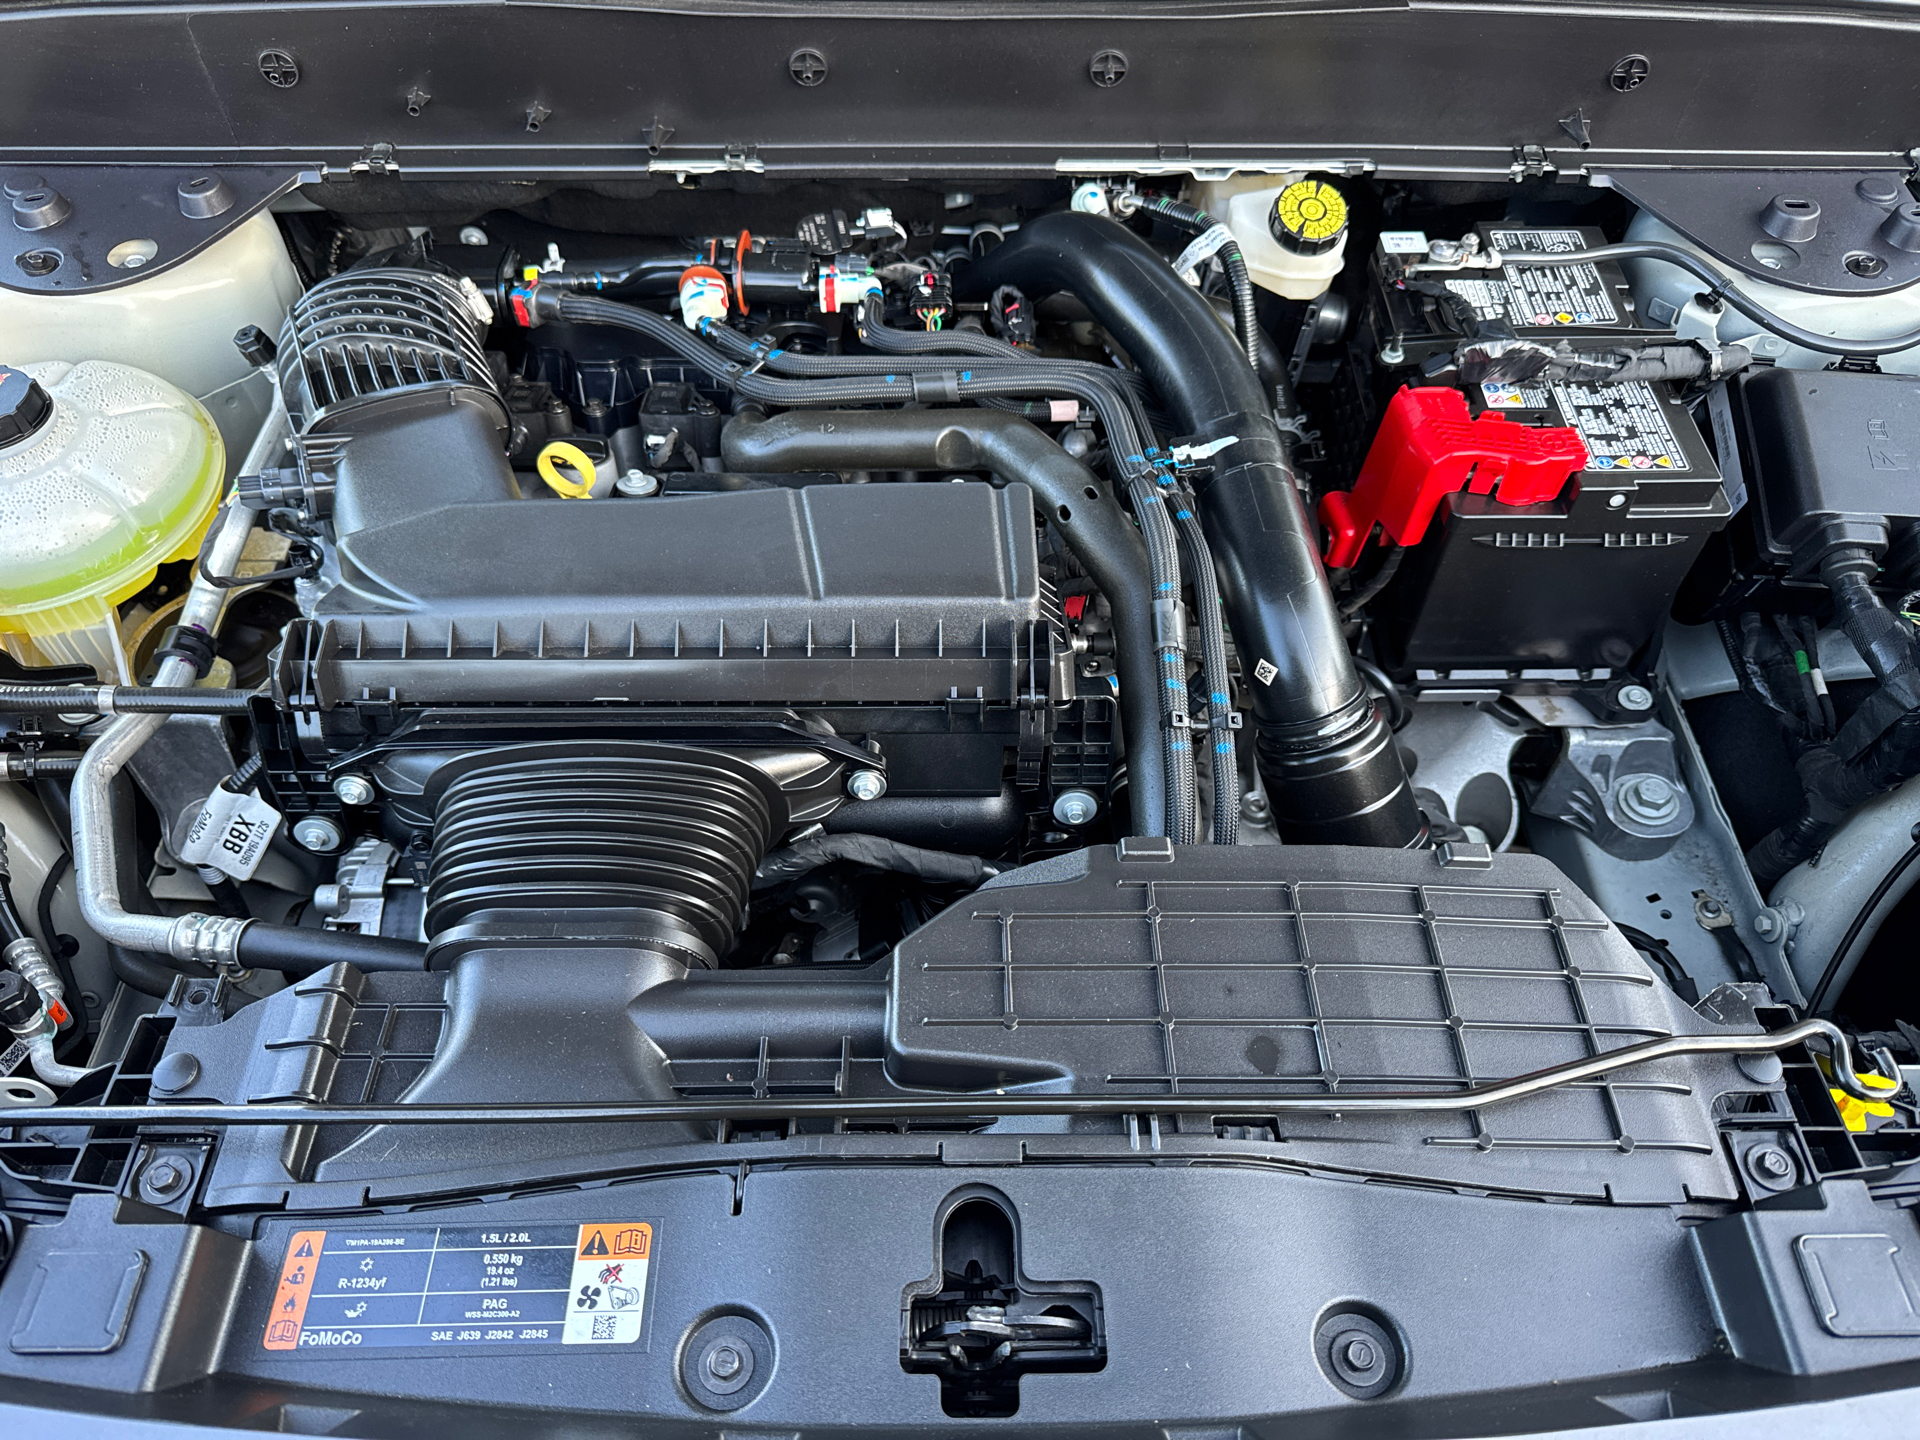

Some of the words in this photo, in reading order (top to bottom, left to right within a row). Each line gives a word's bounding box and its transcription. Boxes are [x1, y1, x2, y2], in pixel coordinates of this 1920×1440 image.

[189, 808, 213, 844] FoMoCo
[222, 813, 256, 855] XBB
[481, 1233, 502, 1243] 1.5L
[509, 1232, 532, 1242] 2.0L
[483, 1254, 509, 1265] 0.550
[511, 1253, 524, 1266] kg
[486, 1266, 502, 1275] 19.4
[338, 1277, 388, 1290] R-1234yf
[481, 1277, 500, 1288] (1.21
[502, 1277, 518, 1287] lbs)
[482, 1299, 508, 1309] PAG
[298, 1330, 362, 1346] FoMoCo
[431, 1331, 453, 1341] SAE
[457, 1330, 481, 1340] J639
[484, 1330, 514, 1340] J2842
[519, 1329, 549, 1339] J2845
